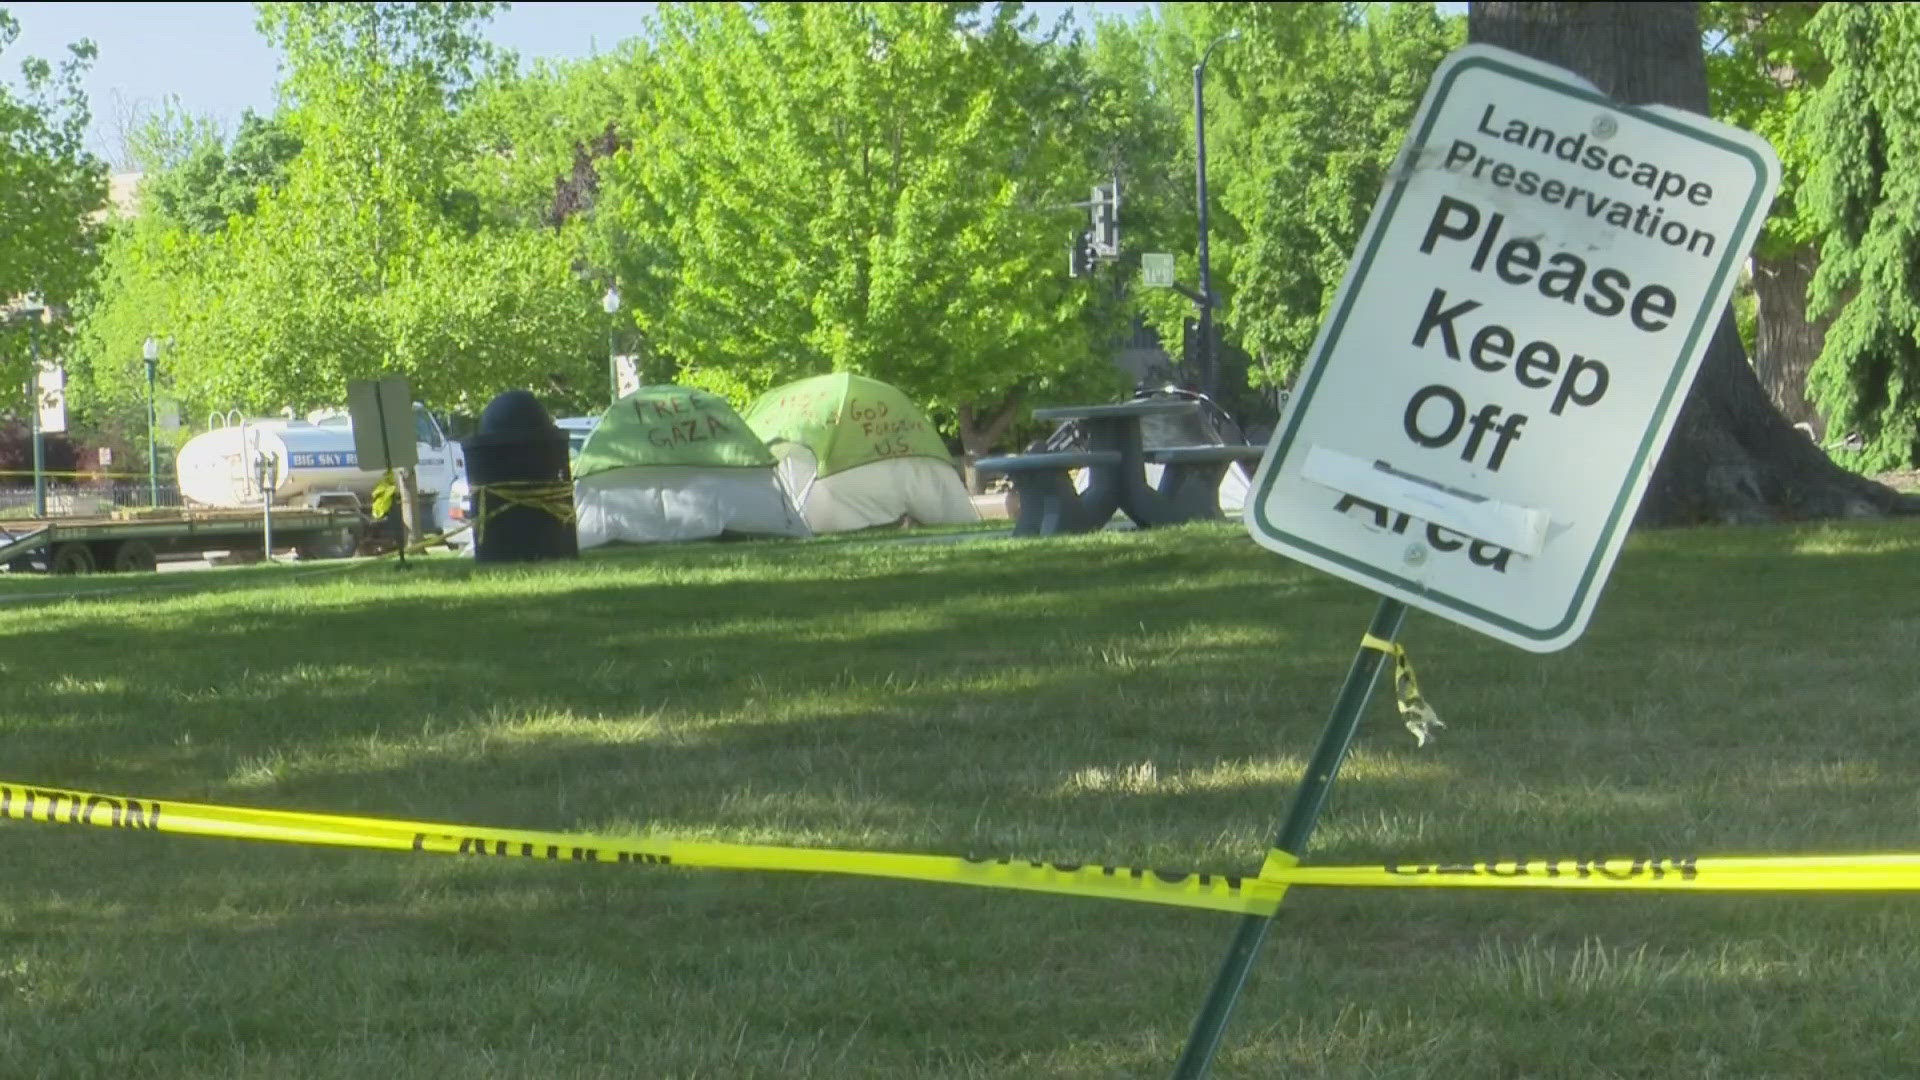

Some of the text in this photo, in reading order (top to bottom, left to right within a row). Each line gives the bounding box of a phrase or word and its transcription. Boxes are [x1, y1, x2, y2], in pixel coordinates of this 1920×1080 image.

[1444, 139, 1717, 257] Preservation
[1477, 103, 1713, 207] Landscape
[1419, 195, 1678, 332] Please
[1411, 287, 1611, 417] Keep
[293, 453, 314, 466] BIG
[318, 453, 341, 466] SKY
[647, 415, 730, 450] GAZA
[1403, 384, 1529, 473] Off
